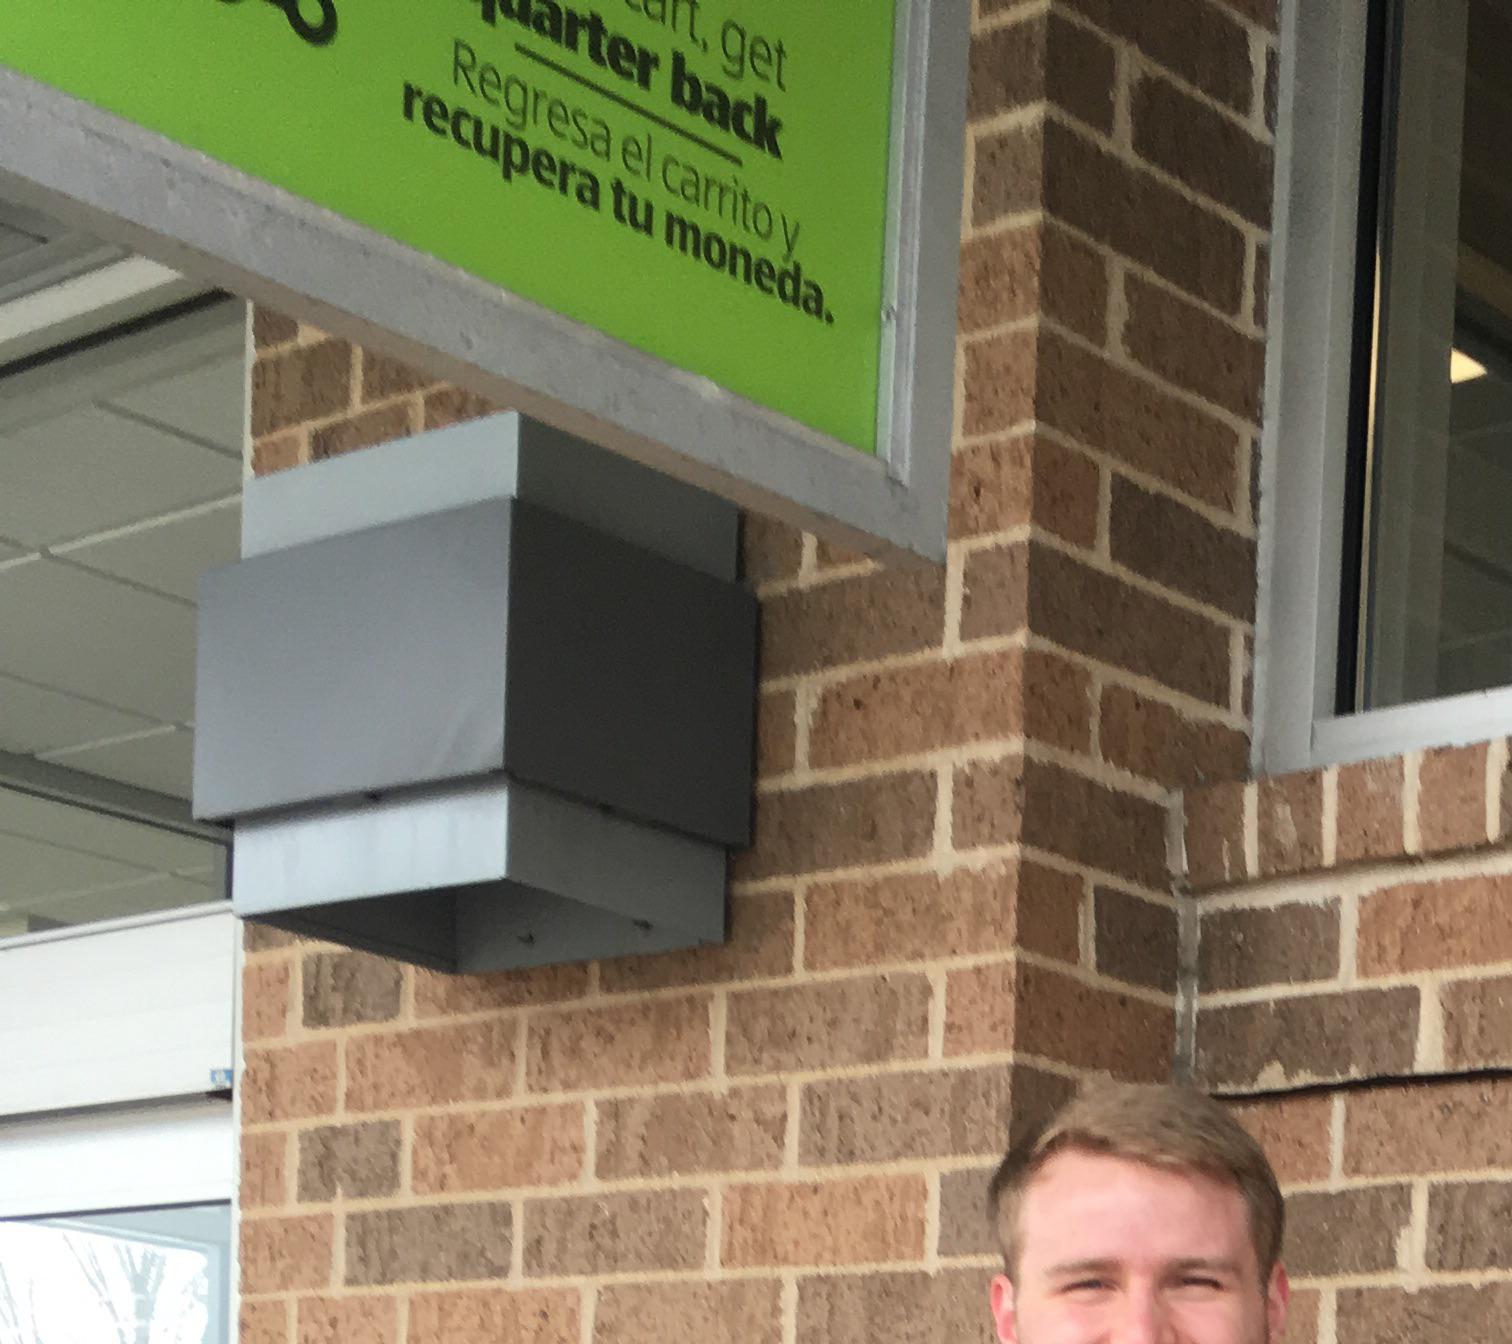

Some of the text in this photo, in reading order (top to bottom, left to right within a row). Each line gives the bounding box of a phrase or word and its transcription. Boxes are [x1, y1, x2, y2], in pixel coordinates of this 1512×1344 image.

[624, 0, 787, 92] art, get
[671, 48, 782, 160] back
[403, 80, 834, 324] recupera tu moneda.
[453, 38, 800, 263] Regresa el carrito y
